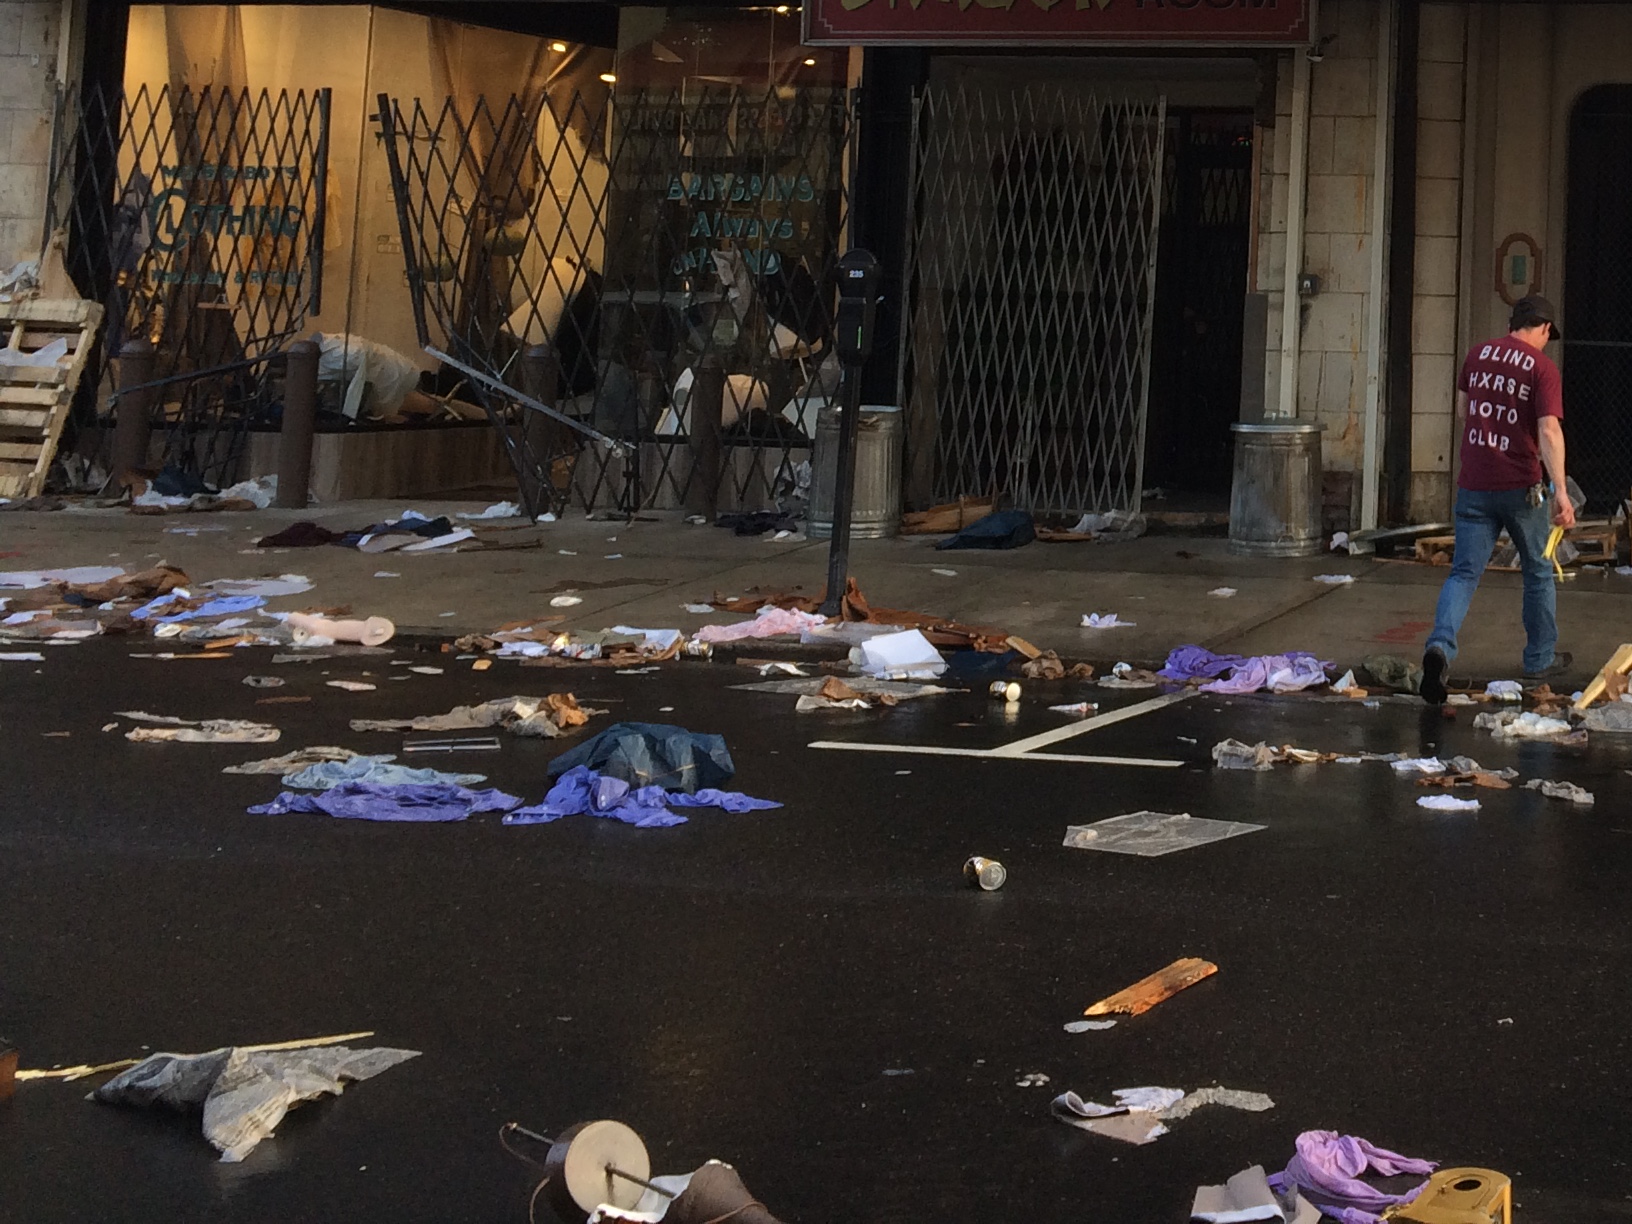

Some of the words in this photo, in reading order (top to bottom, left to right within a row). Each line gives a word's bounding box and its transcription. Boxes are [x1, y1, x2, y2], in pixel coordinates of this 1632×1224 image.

[148, 188, 302, 252] CLOTHING
[1479, 345, 1535, 372] BLIND
[1469, 371, 1532, 401] HXRSE
[1469, 428, 1510, 452] CLUB
